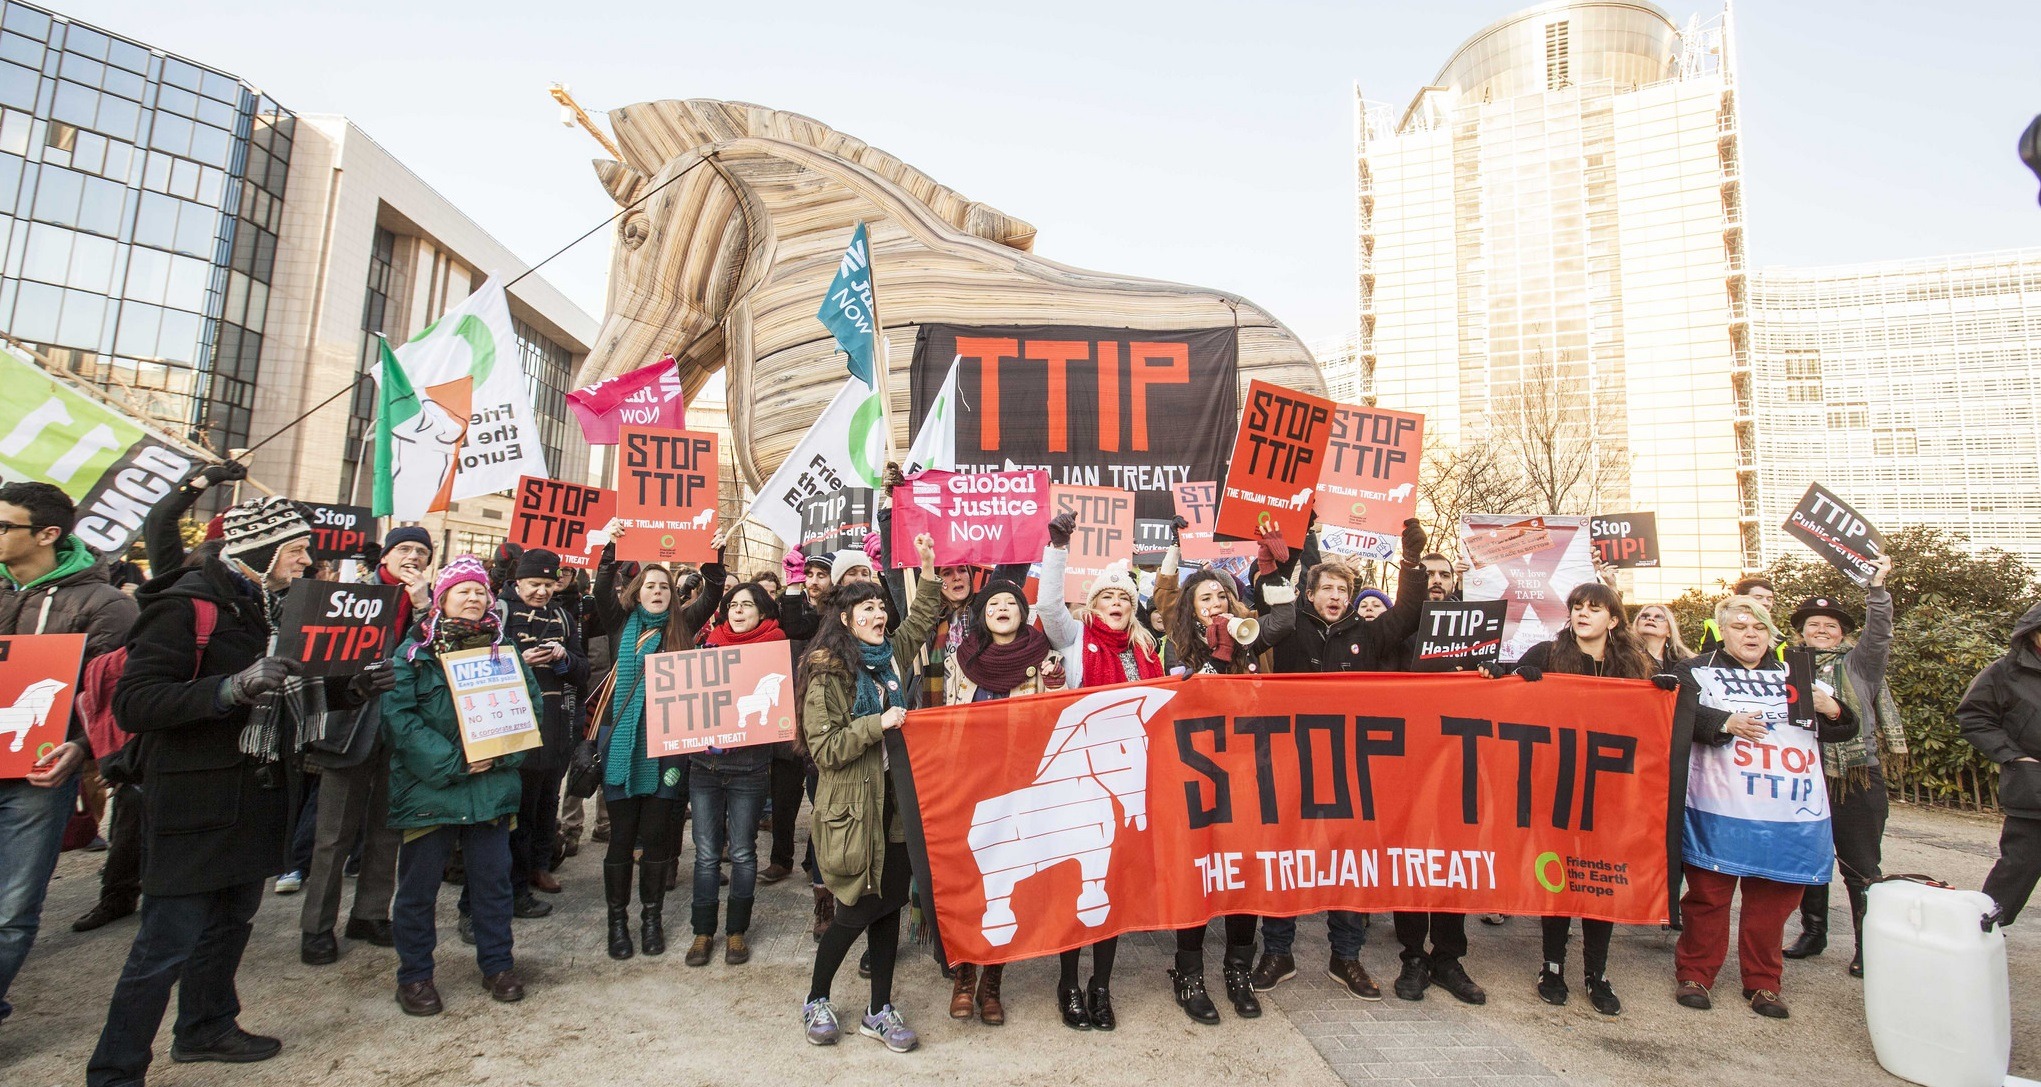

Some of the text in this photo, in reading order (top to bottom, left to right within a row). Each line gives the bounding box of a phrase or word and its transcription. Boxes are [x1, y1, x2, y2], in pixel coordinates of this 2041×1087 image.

[831, 287, 872, 333] Now
[955, 336, 1190, 453] TTIP
[1248, 389, 1329, 443] STOP
[1330, 409, 1416, 446] STOP
[627, 433, 711, 471] STOP
[1249, 433, 1314, 484] TTIP
[1330, 440, 1407, 480] TTIP
[632, 470, 705, 507] TTIP
[948, 473, 1036, 493] Global
[1108, 465, 1190, 491] TREATY
[522, 479, 600, 517] STOP
[1227, 487, 1290, 509] THE TROJAN TREATY
[1316, 483, 1387, 501] HE TROJAN TREATY
[314, 507, 357, 529] Stop
[808, 495, 846, 525] TTIP
[948, 496, 1037, 517] Justice
[1057, 493, 1128, 526] STOP
[1811, 491, 1867, 538] TTIP
[520, 512, 585, 548] TTIP
[620, 518, 691, 530] THE TROJAN TREATY
[804, 521, 867, 542] Health Care
[950, 520, 1003, 542] Now
[1591, 520, 1631, 538] Stop
[1067, 526, 1122, 557] TIP
[1345, 532, 1378, 549] TTIP
[1791, 510, 1876, 576] Public Services
[564, 554, 590, 566] TREATY
[1510, 568, 1547, 579] We love
[1515, 590, 1545, 600] TAPE
[1517, 580, 1541, 589] RED
[326, 590, 383, 625] Stop
[1430, 609, 1484, 636] TTIP
[301, 625, 387, 662] TTIP!
[1421, 640, 1496, 658] Health Care
[456, 660, 493, 681] NHS
[655, 649, 741, 692] STOP
[469, 707, 527, 724] NO TO TTIP
[655, 690, 732, 734] TTIP
[479, 725, 513, 737] corporate
[513, 720, 532, 731] greed
[663, 731, 747, 751] THE TROJAN TREATY
[1734, 740, 1816, 774] STOP
[1174, 713, 1638, 831] STOP TTIP
[1741, 771, 1813, 801] TTIP
[1195, 847, 1496, 898] THE TROJAN TREATY
[1566, 856, 1628, 872] Friends of
[1568, 869, 1628, 885] the Earth
[1569, 881, 1614, 896] Europe
